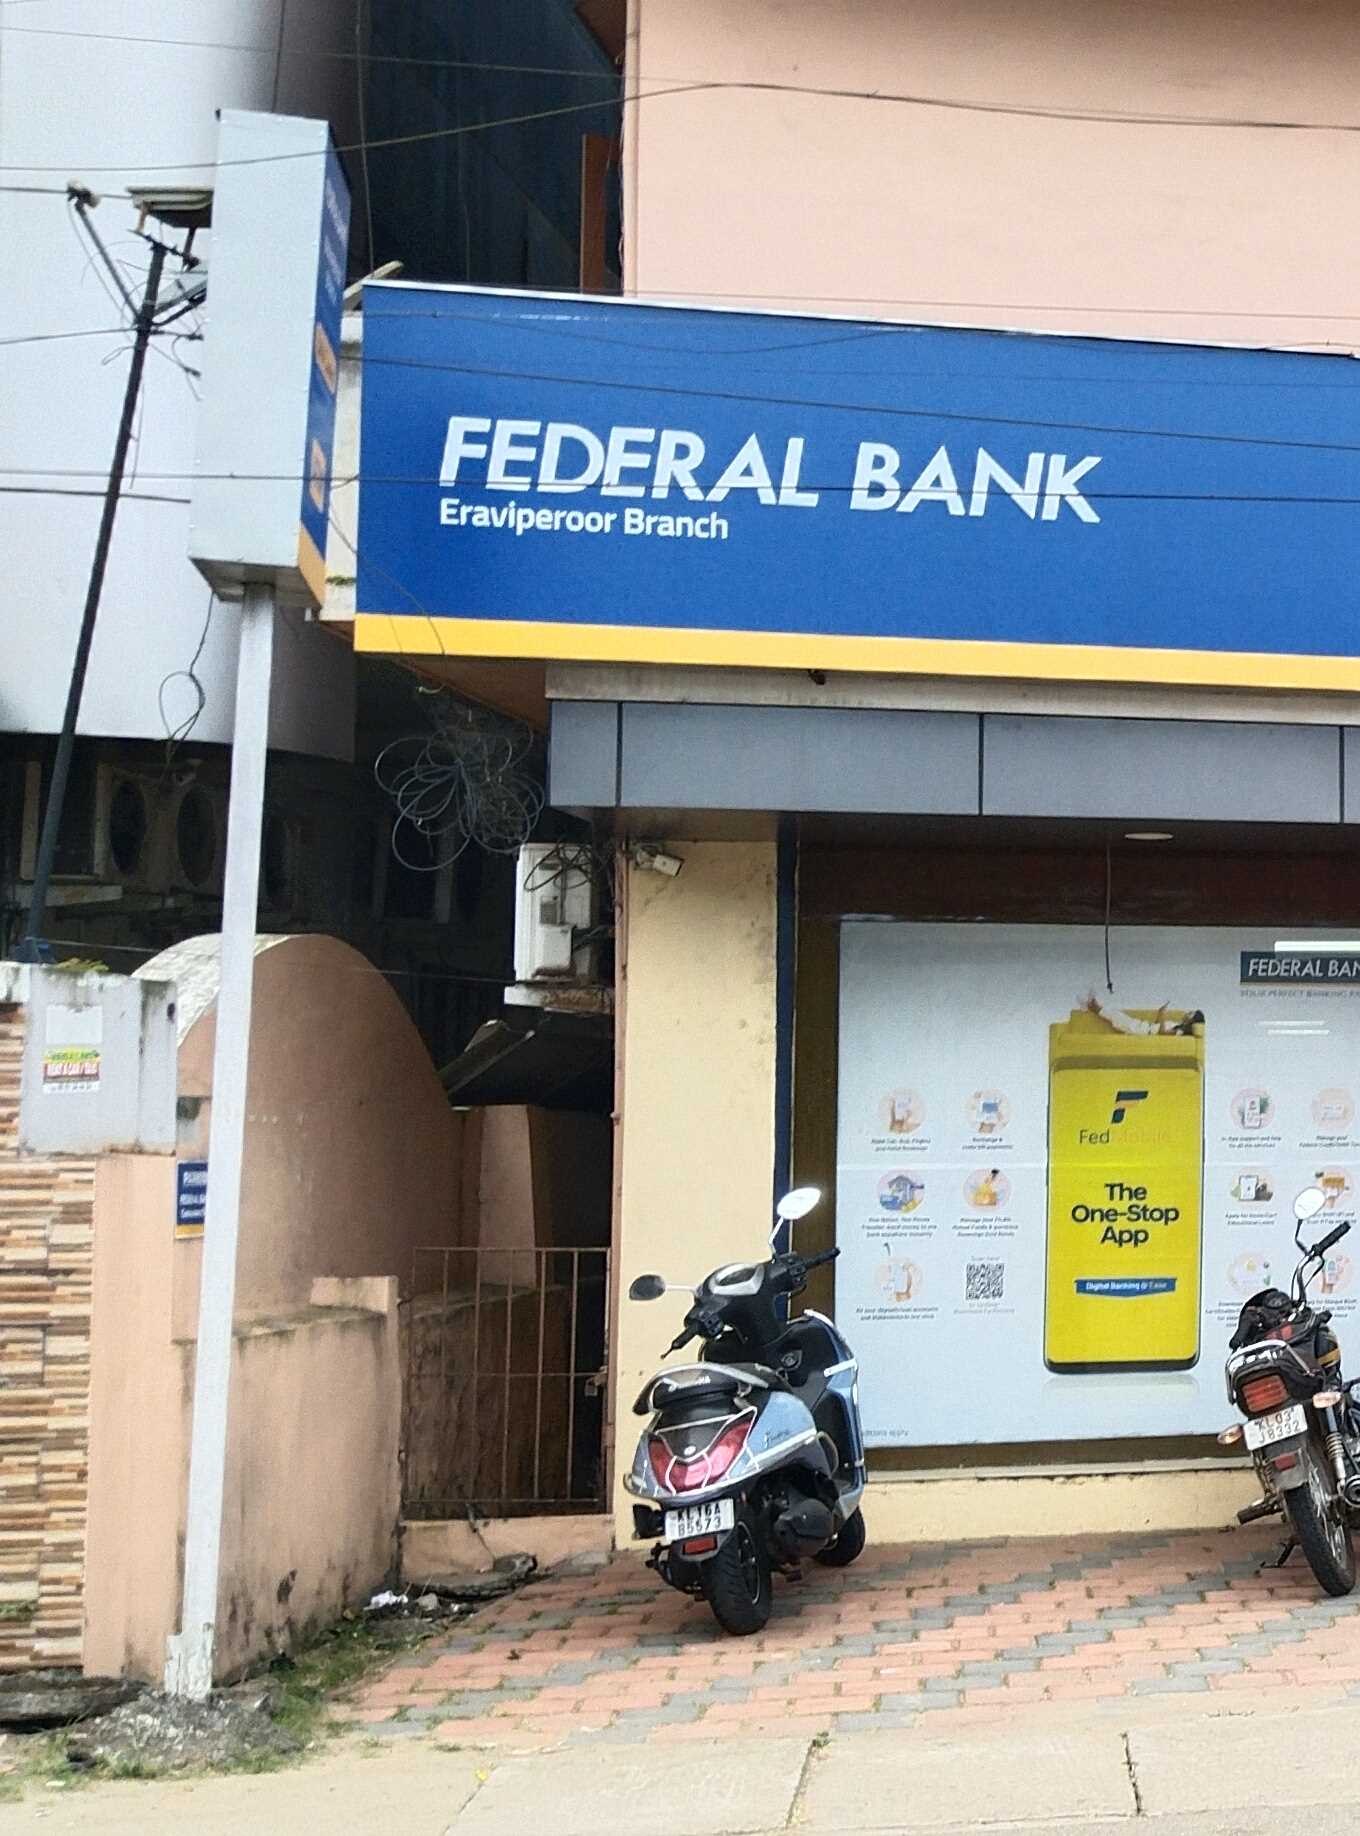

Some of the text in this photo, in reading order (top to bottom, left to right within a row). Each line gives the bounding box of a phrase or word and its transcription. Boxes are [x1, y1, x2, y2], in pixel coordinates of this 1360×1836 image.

[439, 415, 1103, 524] FEDERAL BANK
[440, 498, 729, 540] Eraviperoor Branch
[1248, 958, 1322, 977] FEDERAL
[1104, 1183, 1148, 1201] The
[1071, 1204, 1180, 1226] One-Stop
[1101, 1226, 1149, 1247] App
